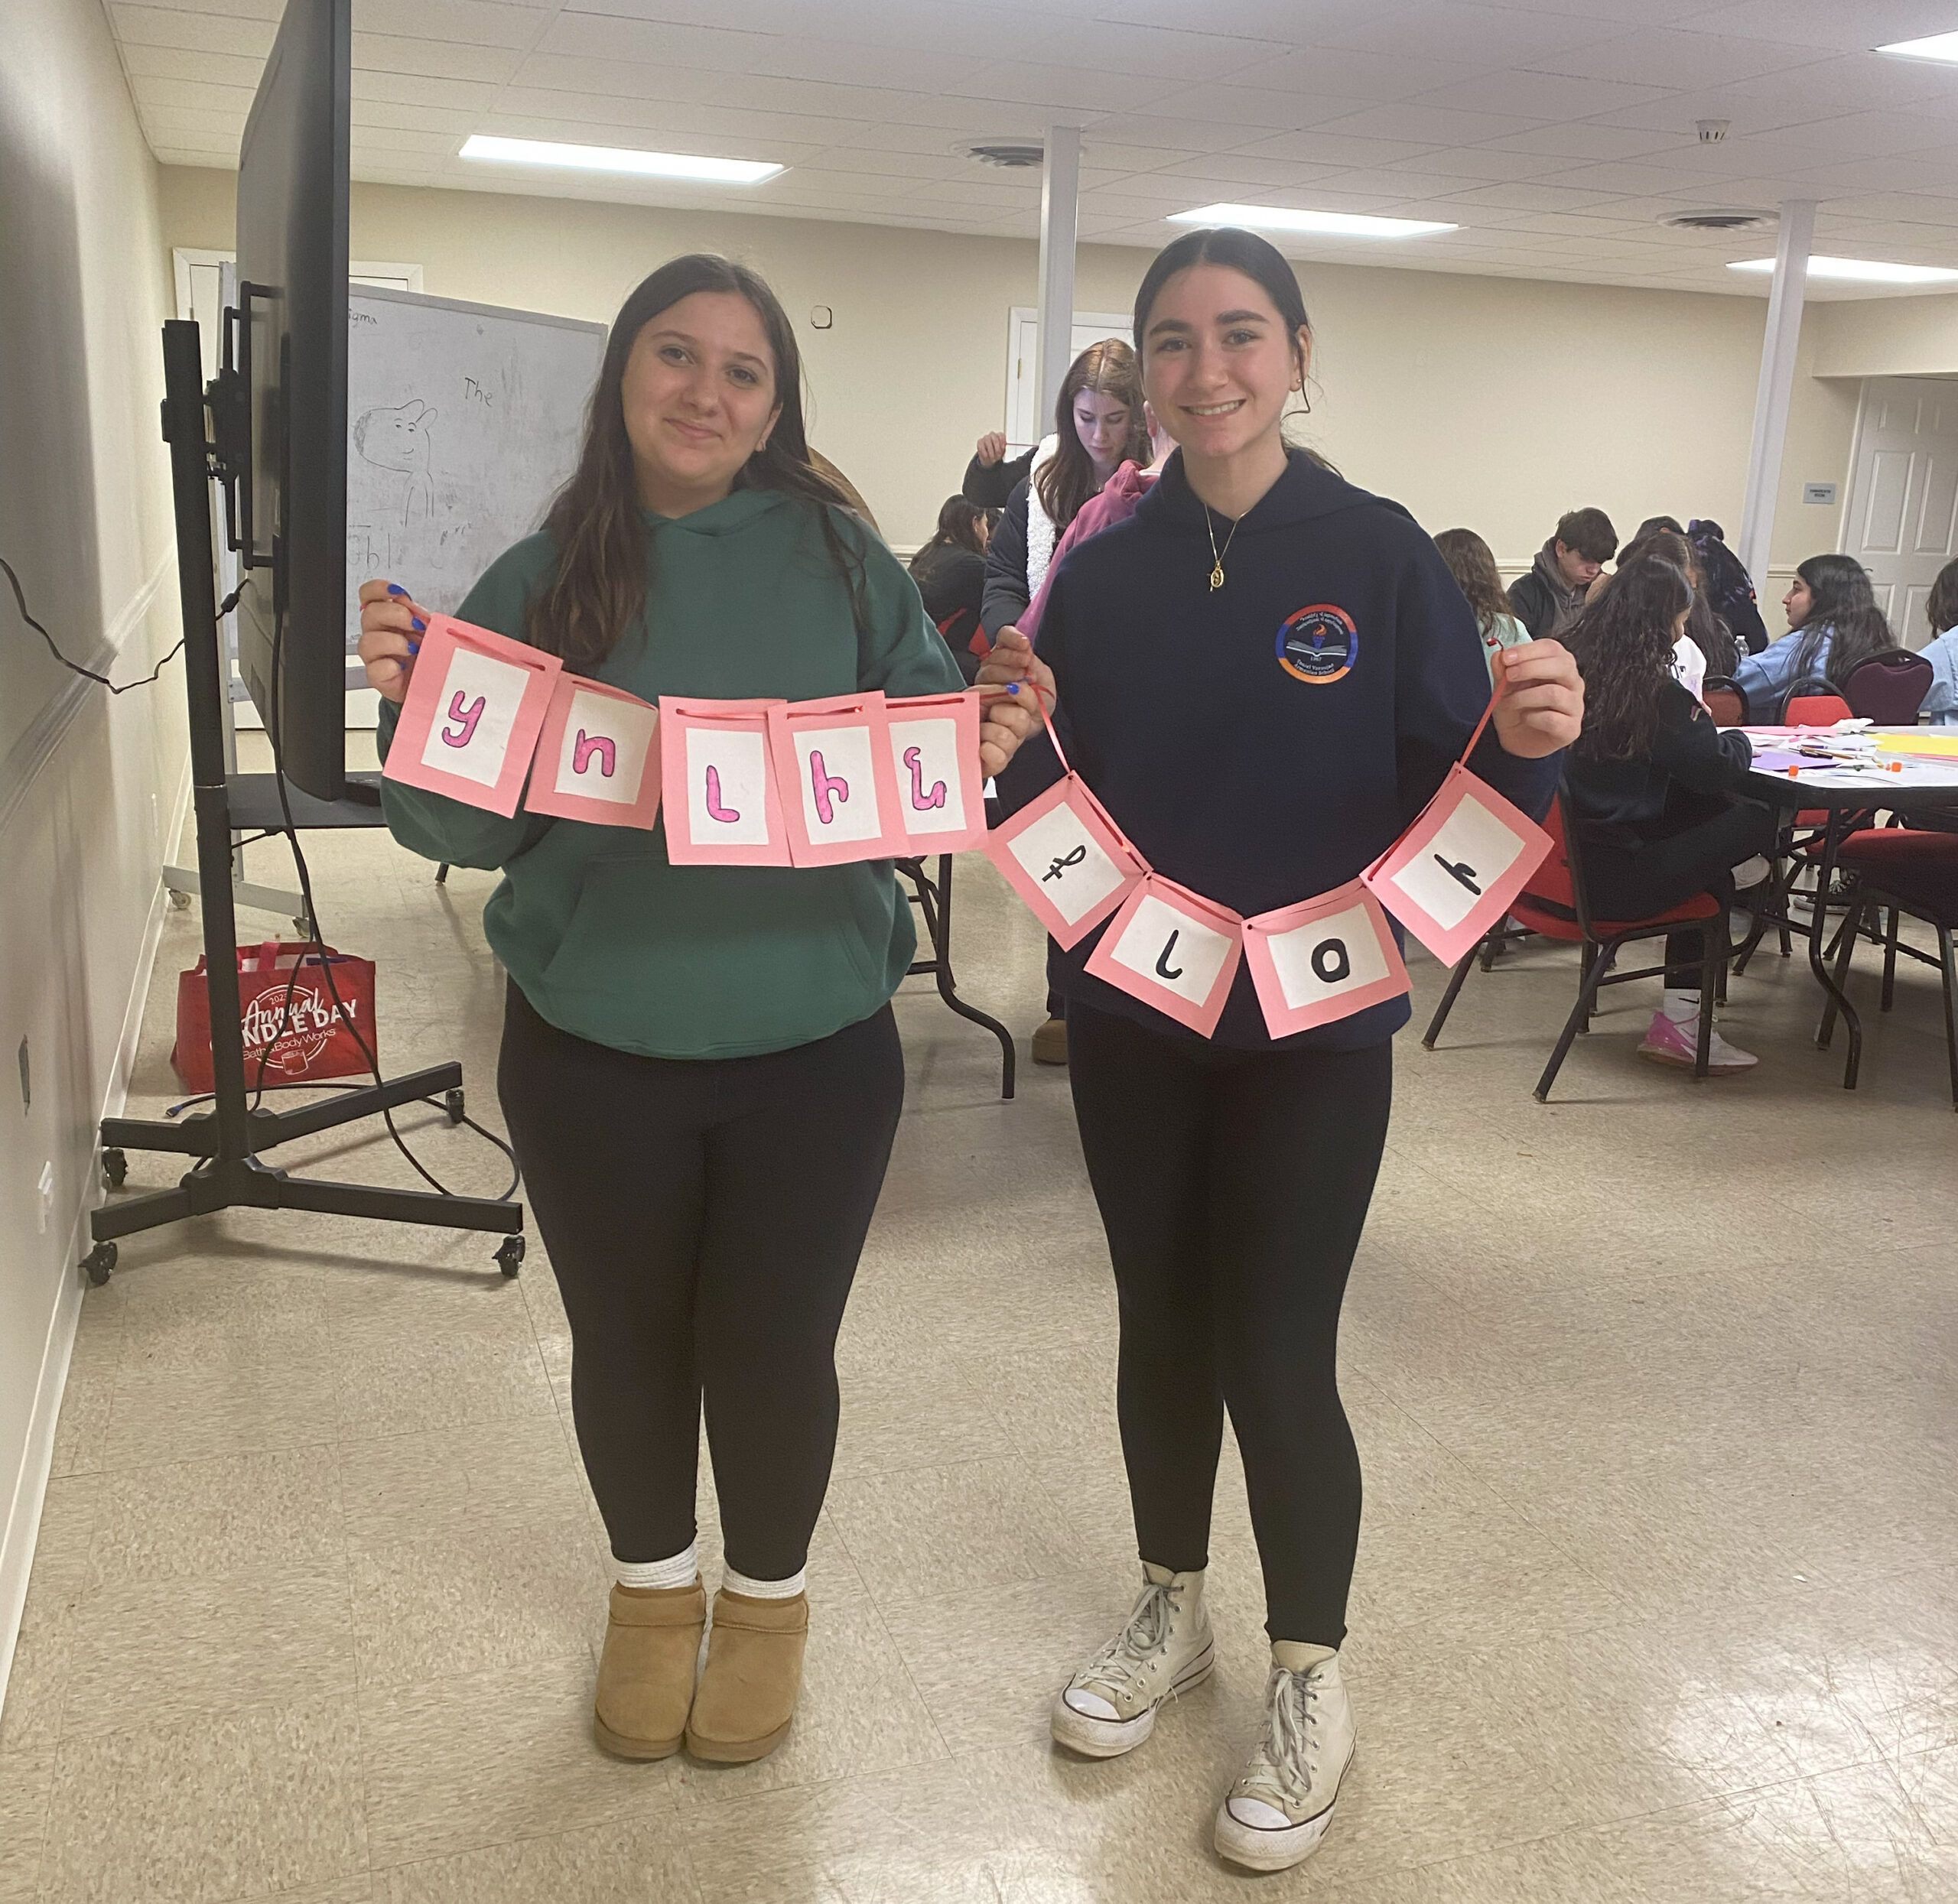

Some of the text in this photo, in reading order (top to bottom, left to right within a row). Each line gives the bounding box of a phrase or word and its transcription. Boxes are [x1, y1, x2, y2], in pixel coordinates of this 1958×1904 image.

[349, 307, 378, 328] igma
[464, 377, 493, 408] The
[241, 987, 324, 1032] Annual
[313, 999, 356, 1028] DAY
[274, 1037, 302, 1051] Body
[301, 1028, 337, 1044] Works
